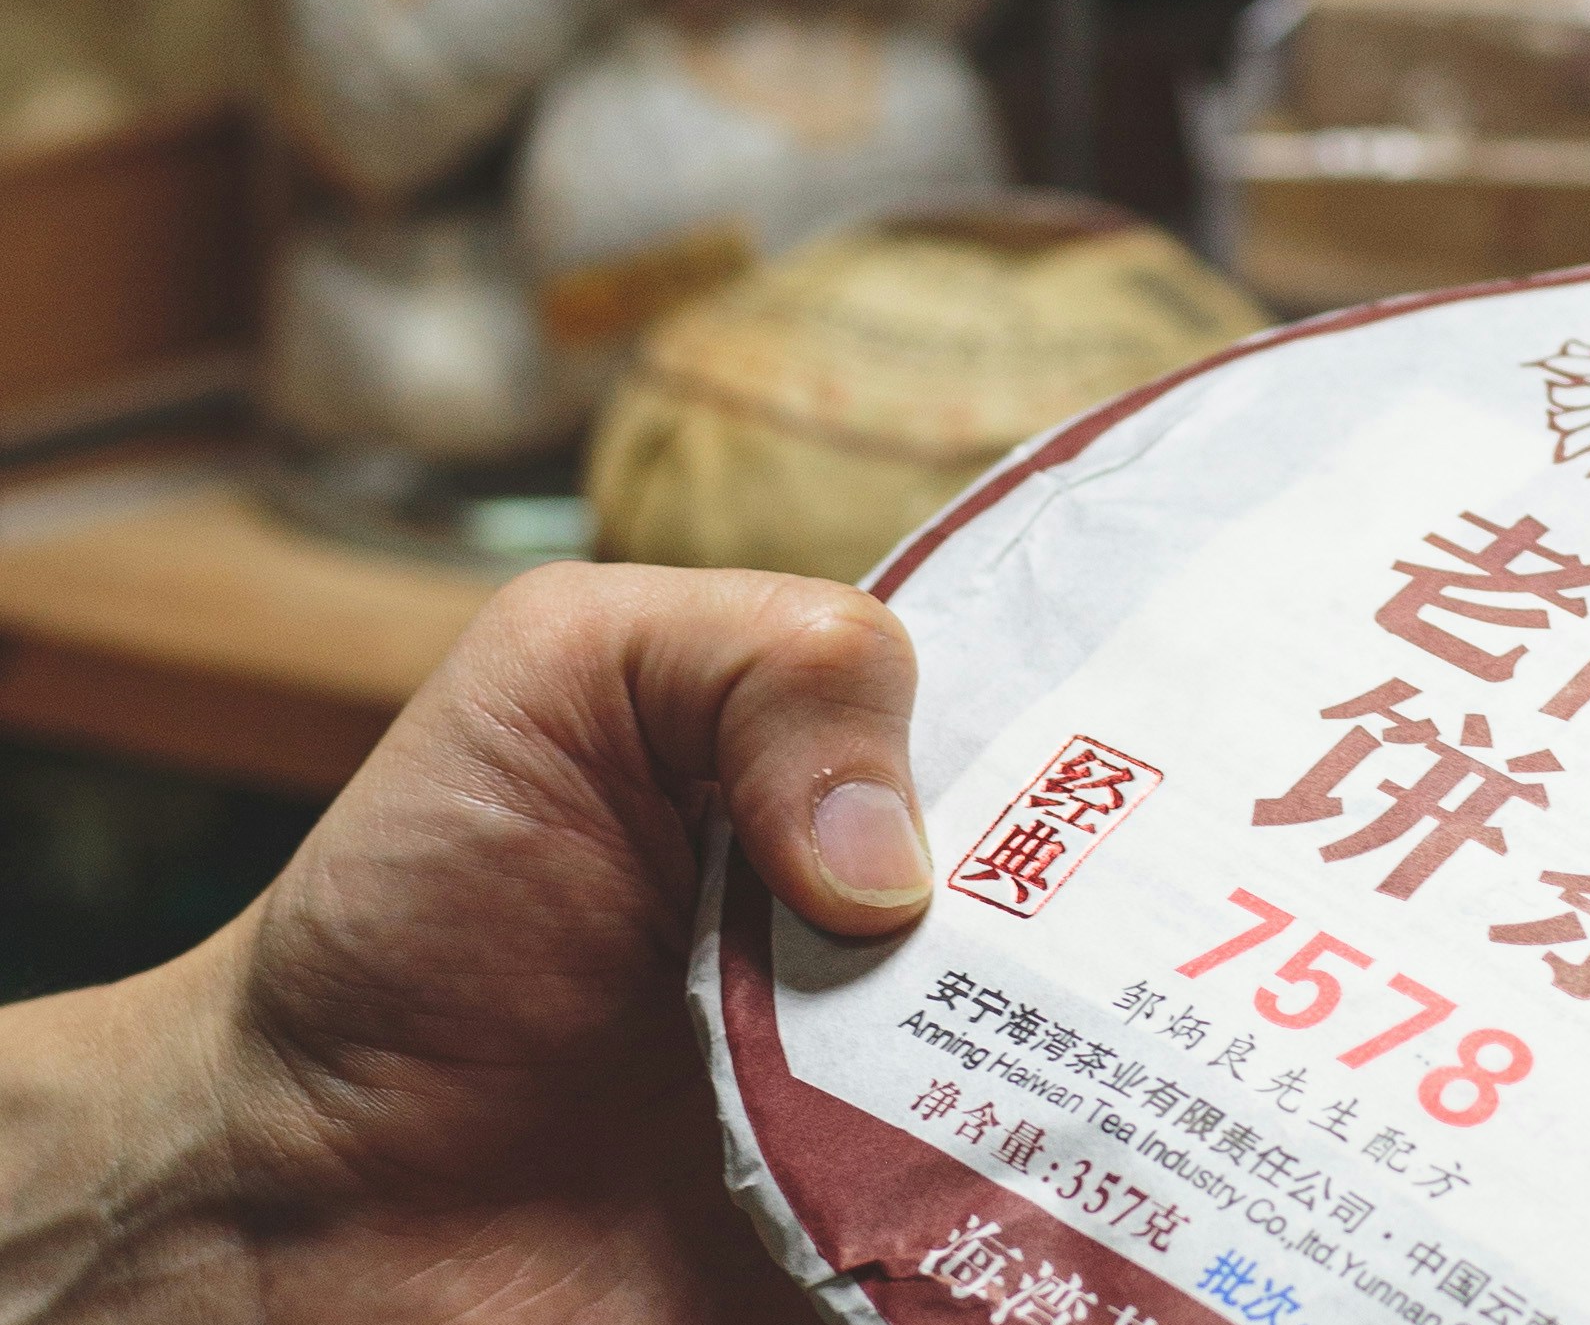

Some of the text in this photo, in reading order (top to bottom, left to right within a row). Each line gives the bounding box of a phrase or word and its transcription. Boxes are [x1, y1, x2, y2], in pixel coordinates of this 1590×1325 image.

[960, 749, 1134, 904] 经典
[898, 1009, 991, 1070] Anning
[986, 1051, 1084, 1114] Haiwan
[1086, 1097, 1138, 1145] Tea
[1136, 1129, 1248, 1211] Industry
[1112, 979, 1472, 1200] 邹炳良先生配方
[1174, 887, 1534, 1128] 7578
